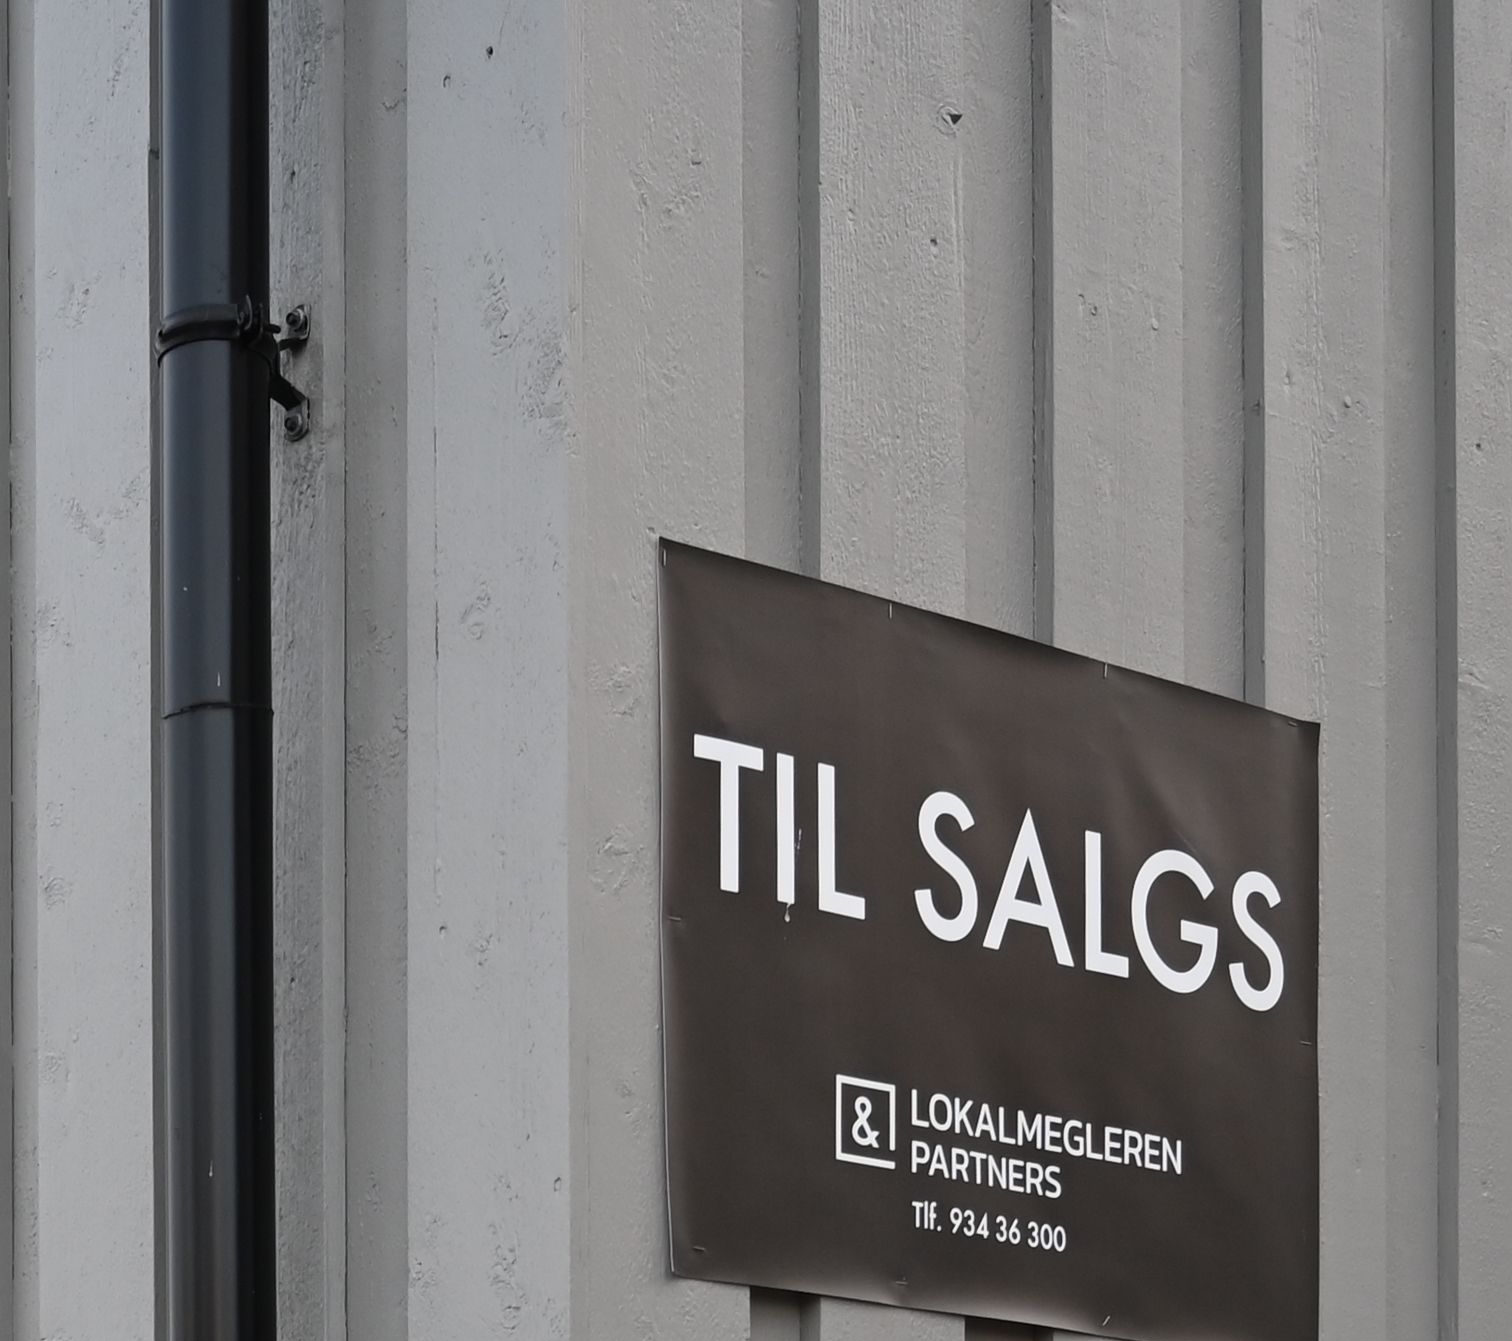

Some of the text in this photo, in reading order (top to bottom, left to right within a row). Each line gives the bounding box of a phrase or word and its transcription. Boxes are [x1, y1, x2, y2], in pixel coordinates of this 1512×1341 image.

[693, 733, 1285, 1012] TIL SALGS
[851, 1095, 880, 1149] &
[911, 1088, 1183, 1175] LOKALMEGLEREN
[910, 1140, 1063, 1199] PARTNERS
[911, 1200, 1067, 1253] Tlf. 934 36 300
